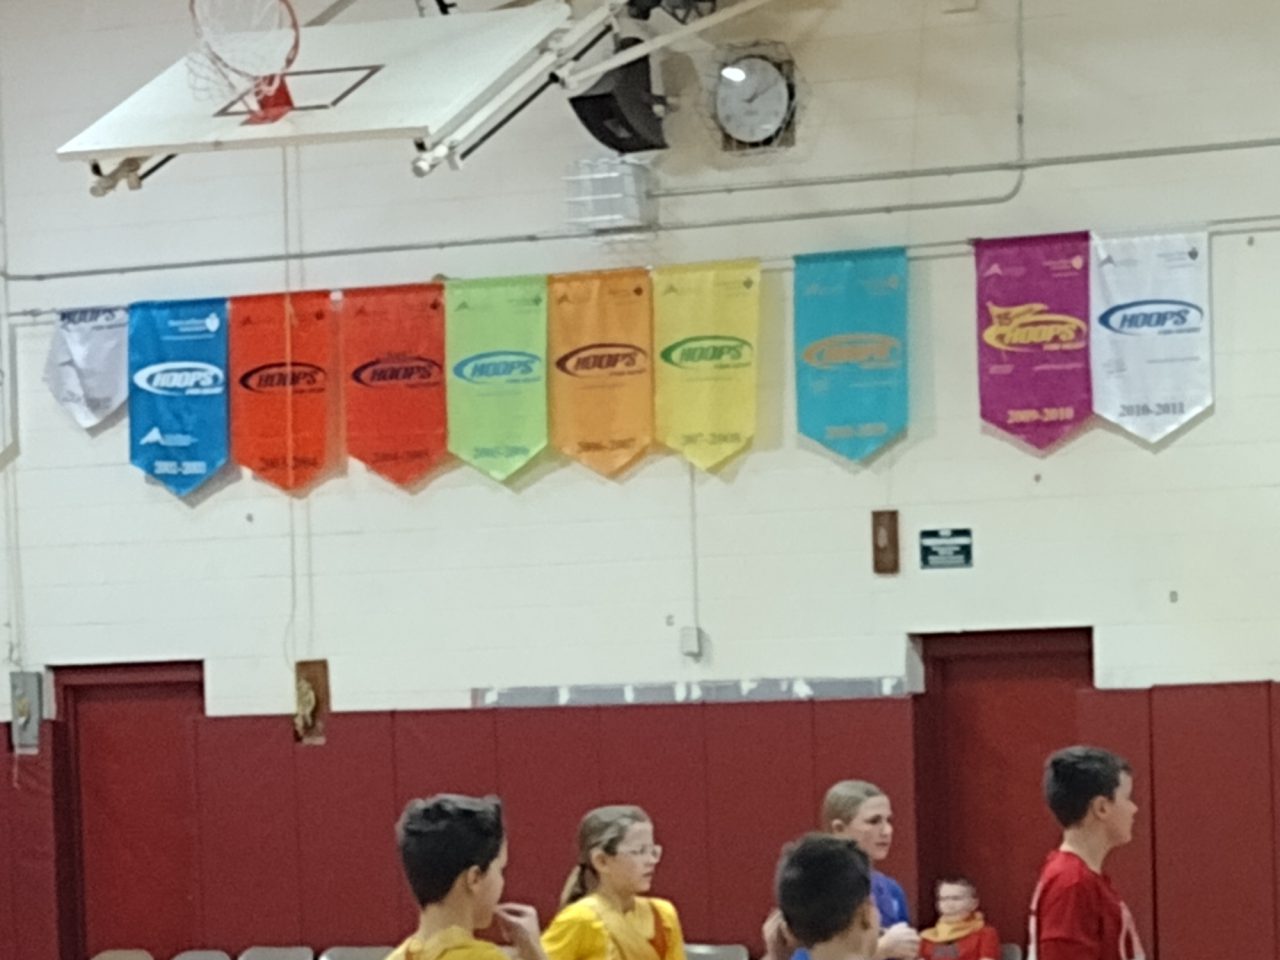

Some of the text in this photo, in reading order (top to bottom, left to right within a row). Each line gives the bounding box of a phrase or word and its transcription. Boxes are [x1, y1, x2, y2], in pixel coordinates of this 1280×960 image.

[1119, 309, 1191, 329] HOOPS
[1005, 324, 1077, 344] HOOPS
[574, 351, 639, 371] HOOPS
[679, 343, 745, 363] HOOPS
[370, 363, 435, 382] HOOPS
[470, 358, 537, 378] HOOPS
[152, 370, 214, 388] HOOPS
